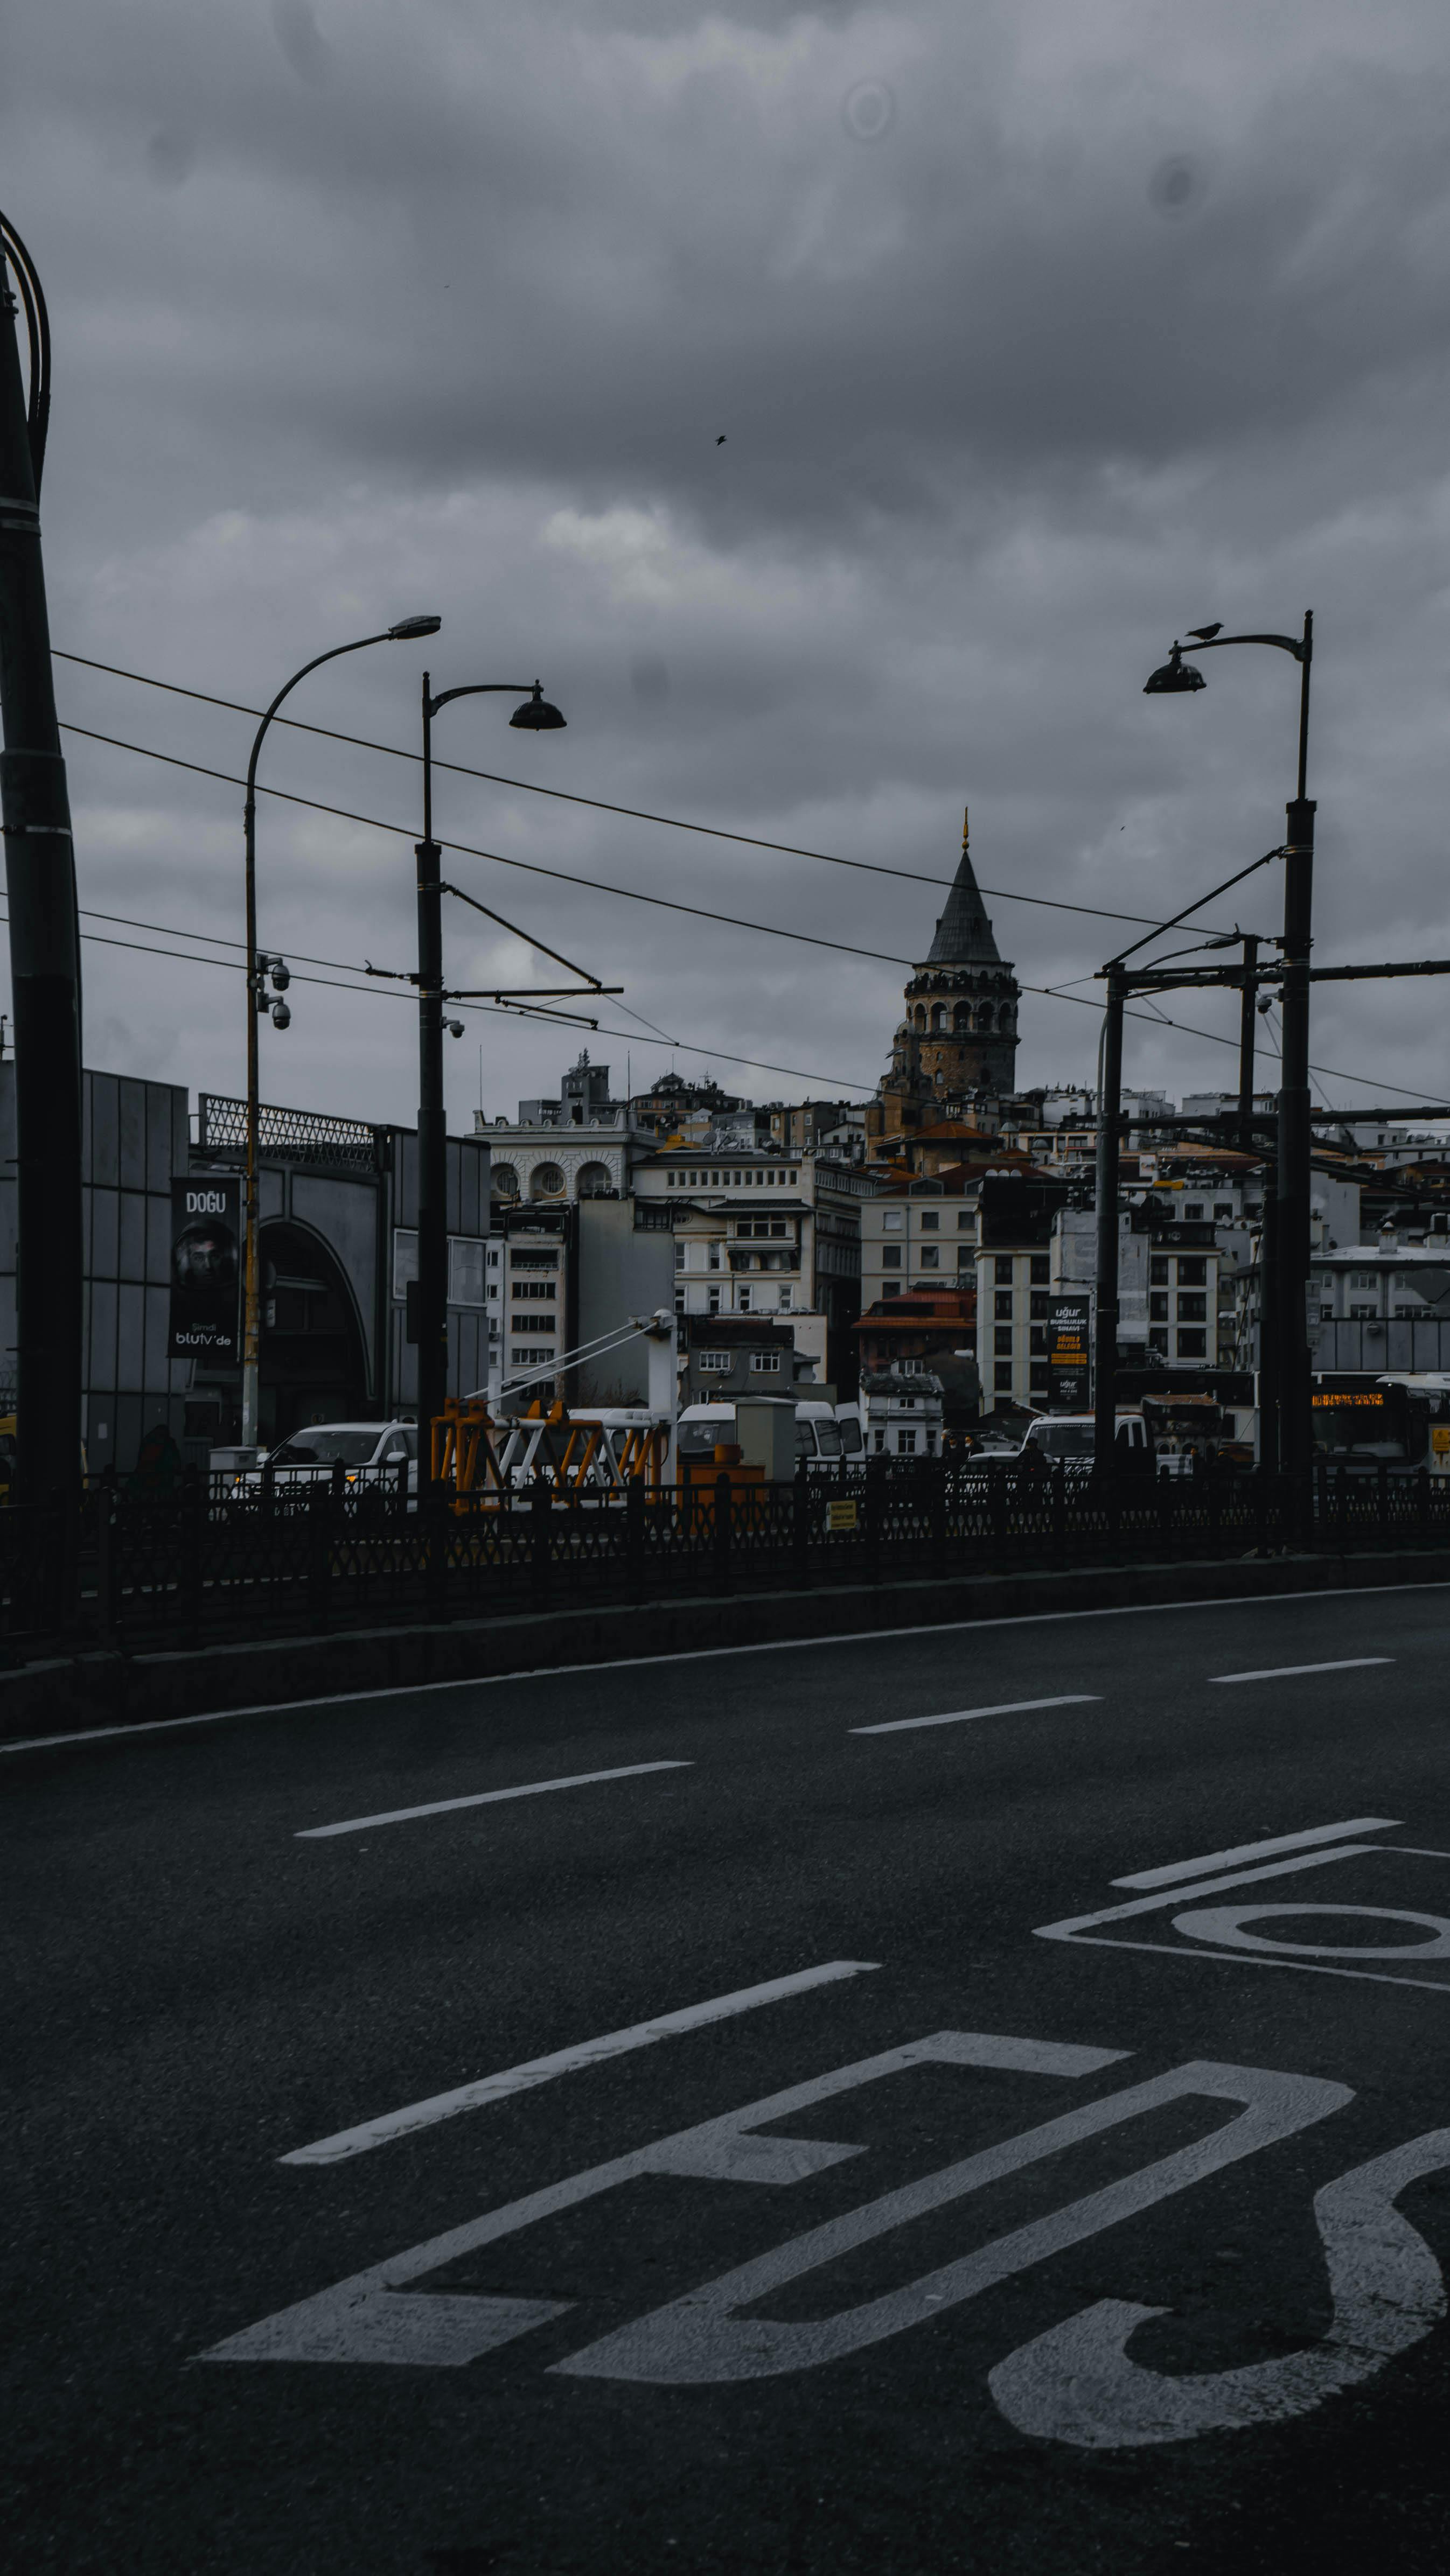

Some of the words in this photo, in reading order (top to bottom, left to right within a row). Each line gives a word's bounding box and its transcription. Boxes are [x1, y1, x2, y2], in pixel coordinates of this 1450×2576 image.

[186, 1191, 226, 1213] DOĞU
[1056, 1306, 1082, 1318] uğur
[192, 1323, 216, 1332] Şimdi
